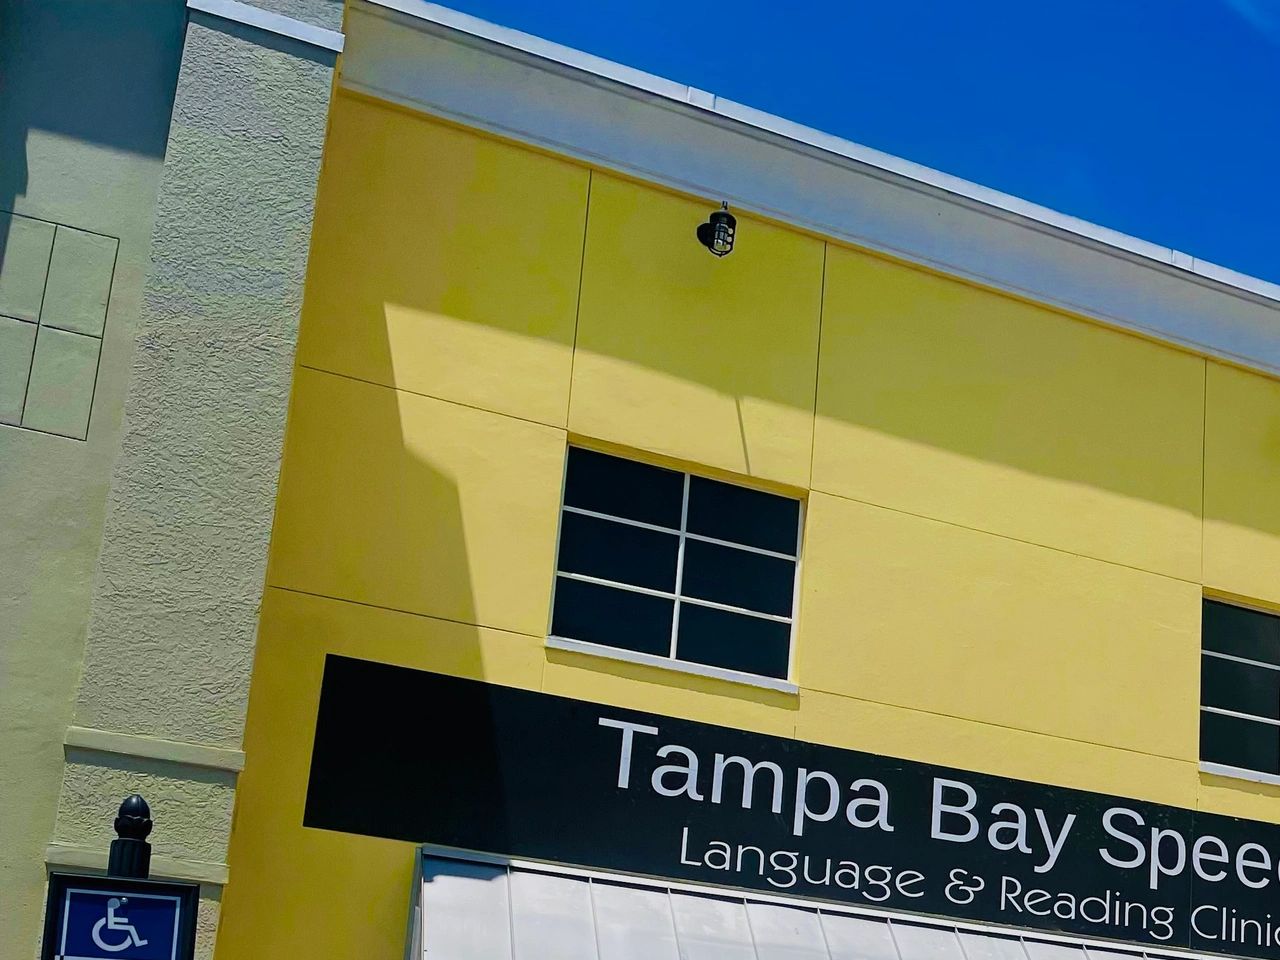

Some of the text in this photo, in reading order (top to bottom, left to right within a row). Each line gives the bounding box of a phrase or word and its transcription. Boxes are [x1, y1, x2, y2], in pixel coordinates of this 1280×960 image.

[598, 717, 895, 837] Tampa
[931, 777, 1077, 873] Bay
[680, 827, 925, 902] Language
[944, 868, 985, 905] &
[1000, 876, 1175, 941] Reading
